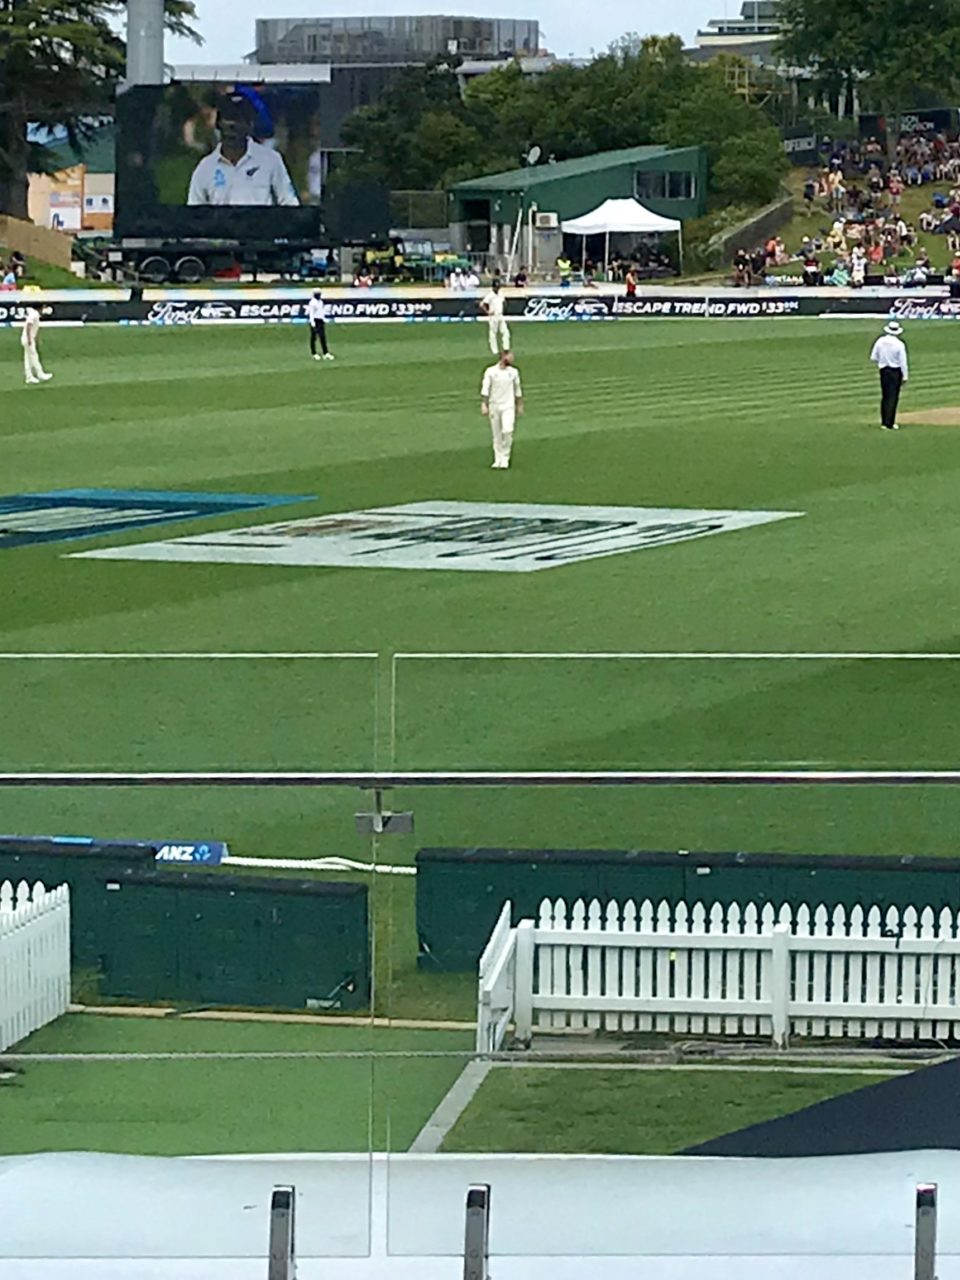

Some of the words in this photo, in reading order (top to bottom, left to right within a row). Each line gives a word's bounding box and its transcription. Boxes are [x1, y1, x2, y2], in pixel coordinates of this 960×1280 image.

[148, 302, 199, 321] Ford
[240, 304, 300, 317] ESCAPE
[303, 303, 353, 316] TEND
[356, 304, 389, 316] FWD
[524, 297, 573, 318] Ford
[613, 301, 670, 314] ESCAPE
[674, 302, 725, 315] TREND
[727, 302, 760, 315] FWD
[889, 297, 940, 319] Ford
[155, 845, 195, 860] ANZ
